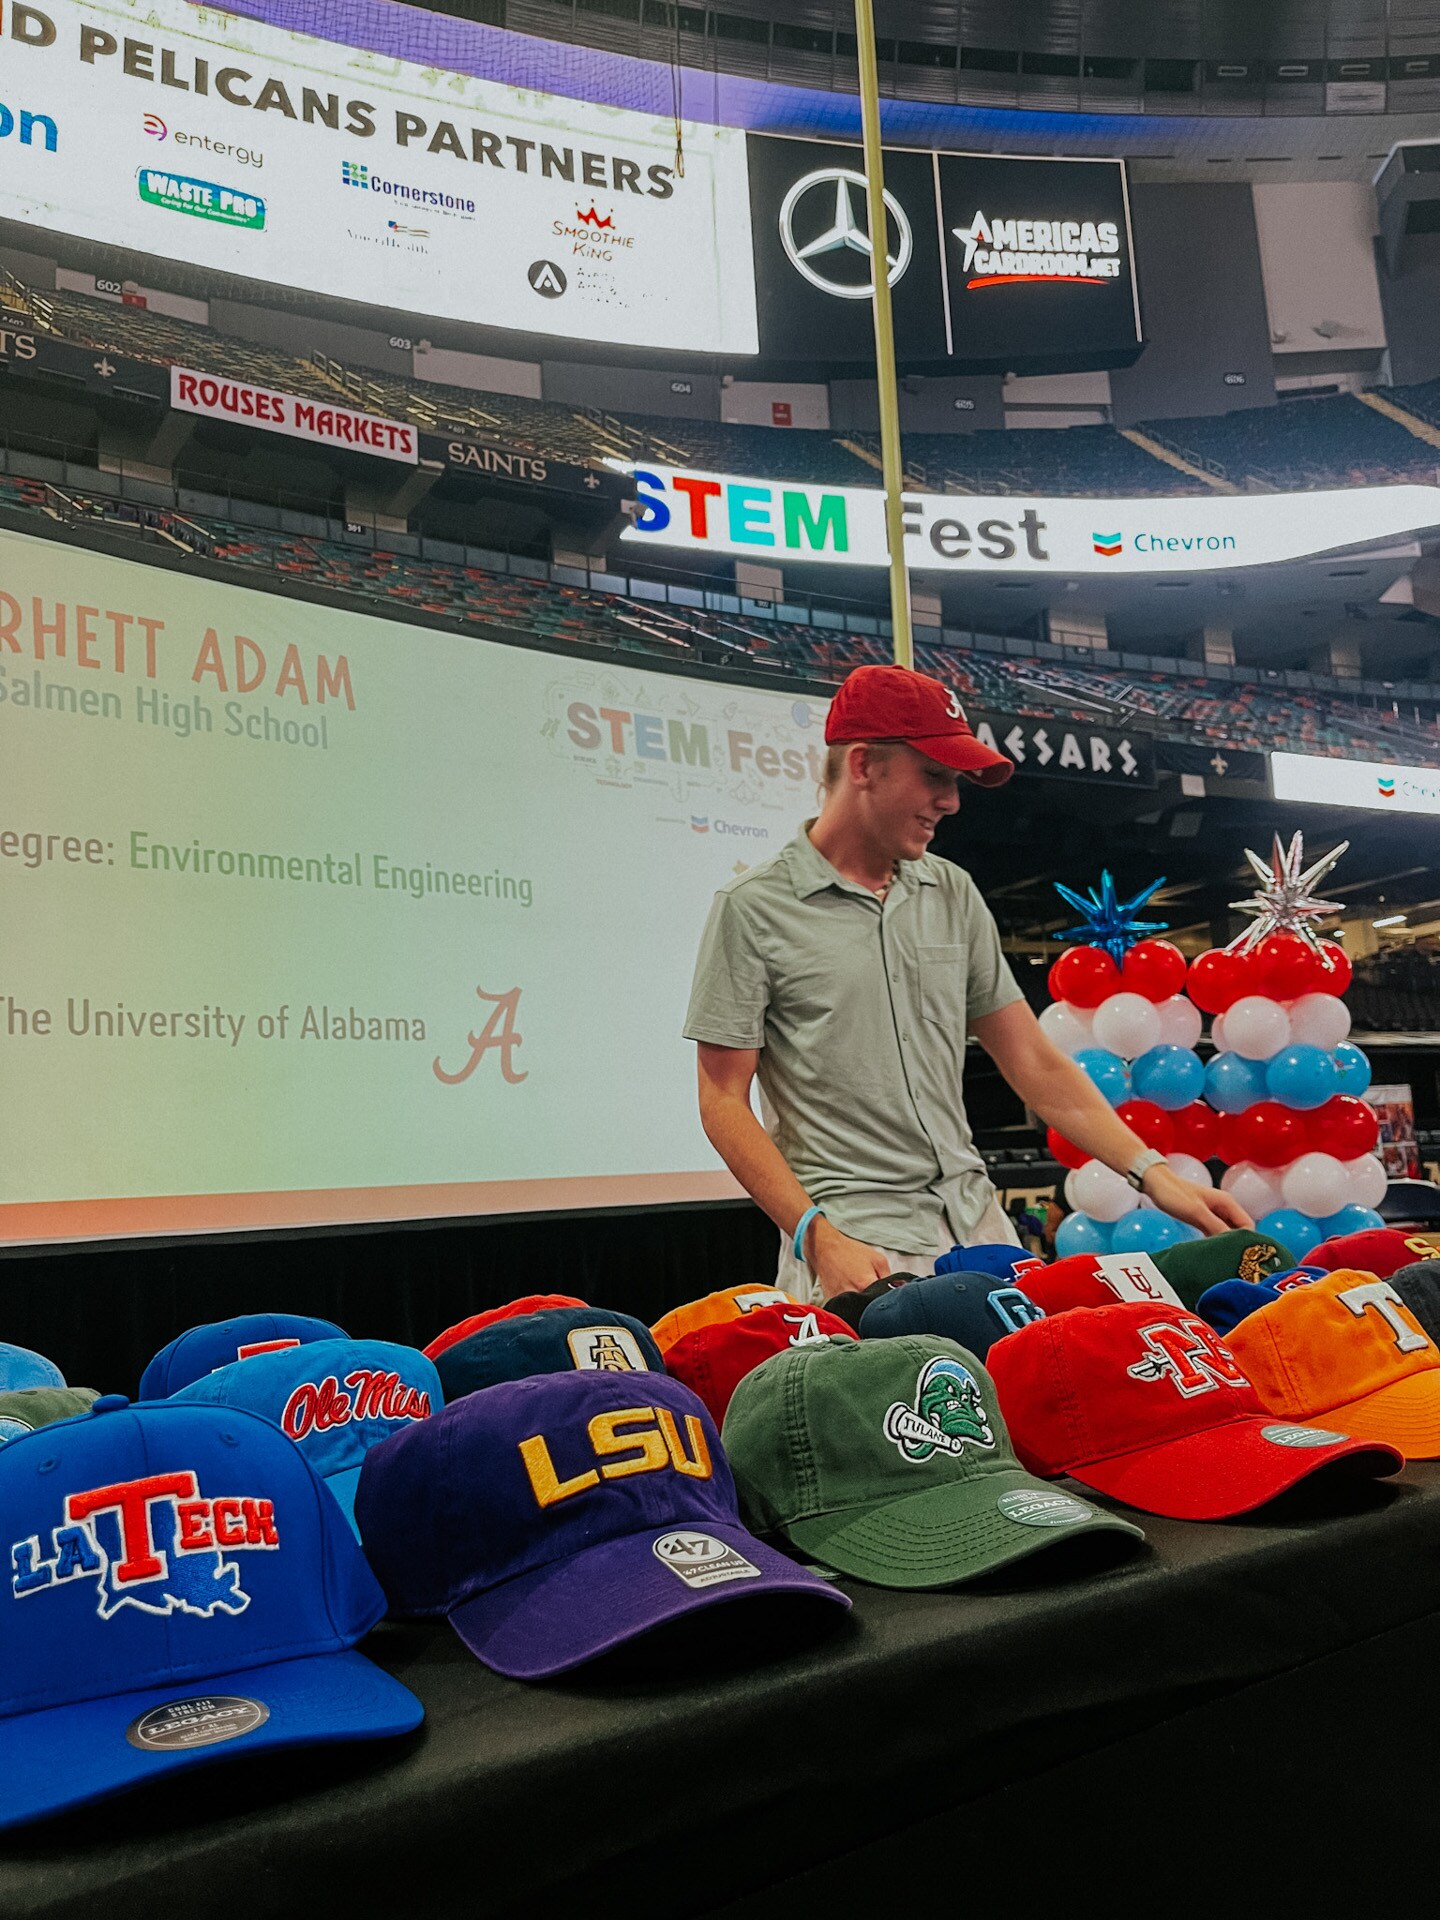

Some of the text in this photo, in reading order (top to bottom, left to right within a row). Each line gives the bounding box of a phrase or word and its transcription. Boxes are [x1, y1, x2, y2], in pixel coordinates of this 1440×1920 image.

[0, 1, 673, 199] D PELICANS PARTNERS
[174, 131, 263, 168] entergy
[146, 171, 258, 218] WASTE PRO
[371, 176, 475, 212] Cornerstone
[552, 221, 634, 248] SMOOTHIE
[952, 210, 1119, 253] AMERICAS
[973, 250, 1121, 277] CARDROOM.NET
[97, 280, 121, 294] 602
[0, 330, 37, 360] TS
[389, 337, 411, 350] 603
[671, 382, 691, 394] 604
[179, 373, 413, 454] ROUSES MARKETS
[448, 442, 547, 481] SAINTS
[634, 470, 1236, 562] STEM Fest Chevron
[0, 591, 356, 711] RHETT ADAM
[136, 686, 213, 738] High
[225, 701, 328, 749] School
[567, 702, 823, 783] STEM Fest
[976, 722, 1139, 777] AESARS
[714, 820, 769, 839] Chevron
[0, 830, 533, 908] egree: Environmental Engineering
[67, 998, 246, 1047] University
[257, 1005, 290, 1040] of
[299, 1005, 426, 1042] Alabama
[1338, 1282, 1429, 1353] T
[282, 1370, 432, 1442] Ole Miss
[904, 1417, 946, 1444] TULANE
[518, 1406, 713, 1509] LSU
[1008, 1500, 1076, 1518] LEGACY
[12, 1471, 279, 1597] LA TECH
[697, 1562, 731, 1572] CLEAN
[148, 1707, 249, 1735] LEGACY
[168, 1703, 191, 1713] COOL
[171, 1704, 216, 1717] STRETCH
